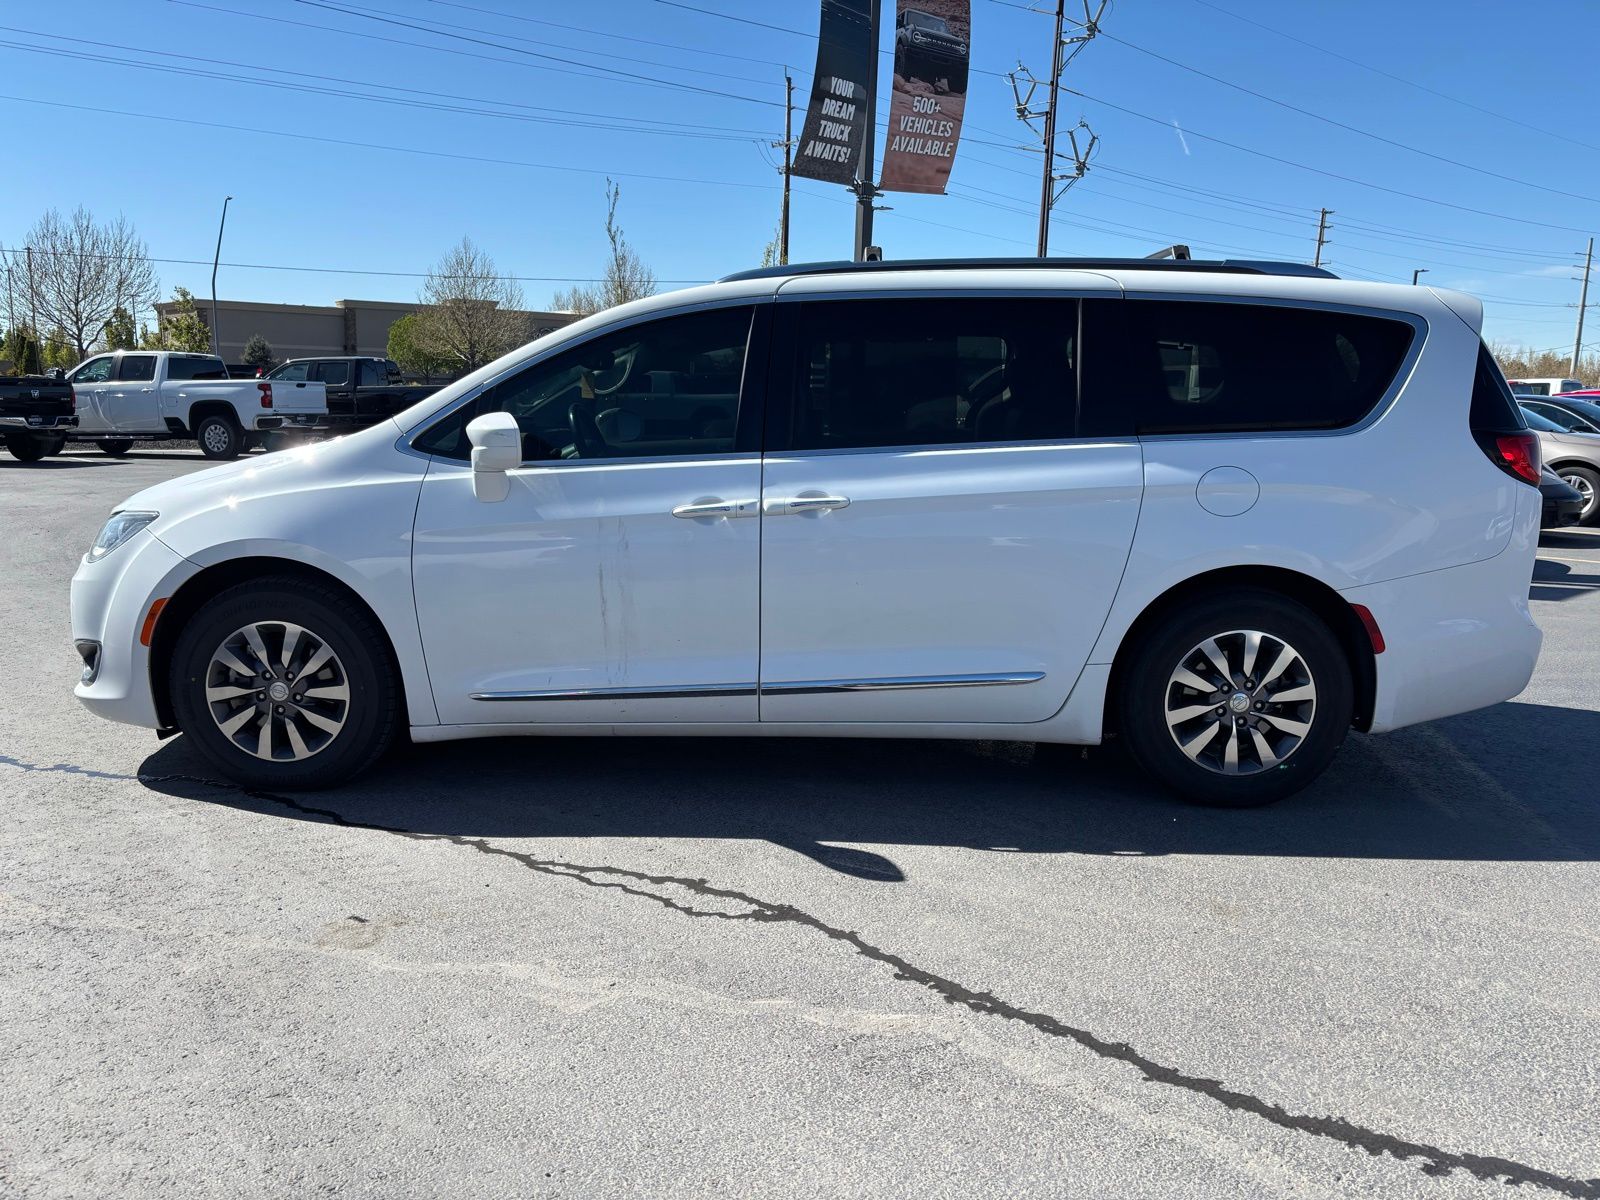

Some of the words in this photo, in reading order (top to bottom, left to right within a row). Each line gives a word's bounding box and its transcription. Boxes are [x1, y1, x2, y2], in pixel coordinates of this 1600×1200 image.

[830, 76, 855, 99] YOUR
[821, 98, 856, 121] DREAM
[913, 96, 942, 115] 500+
[818, 120, 852, 142] TRUCK
[900, 115, 954, 138] VEHICLES
[804, 140, 852, 163] AWAITS!
[890, 135, 954, 158] AVAILABLE
